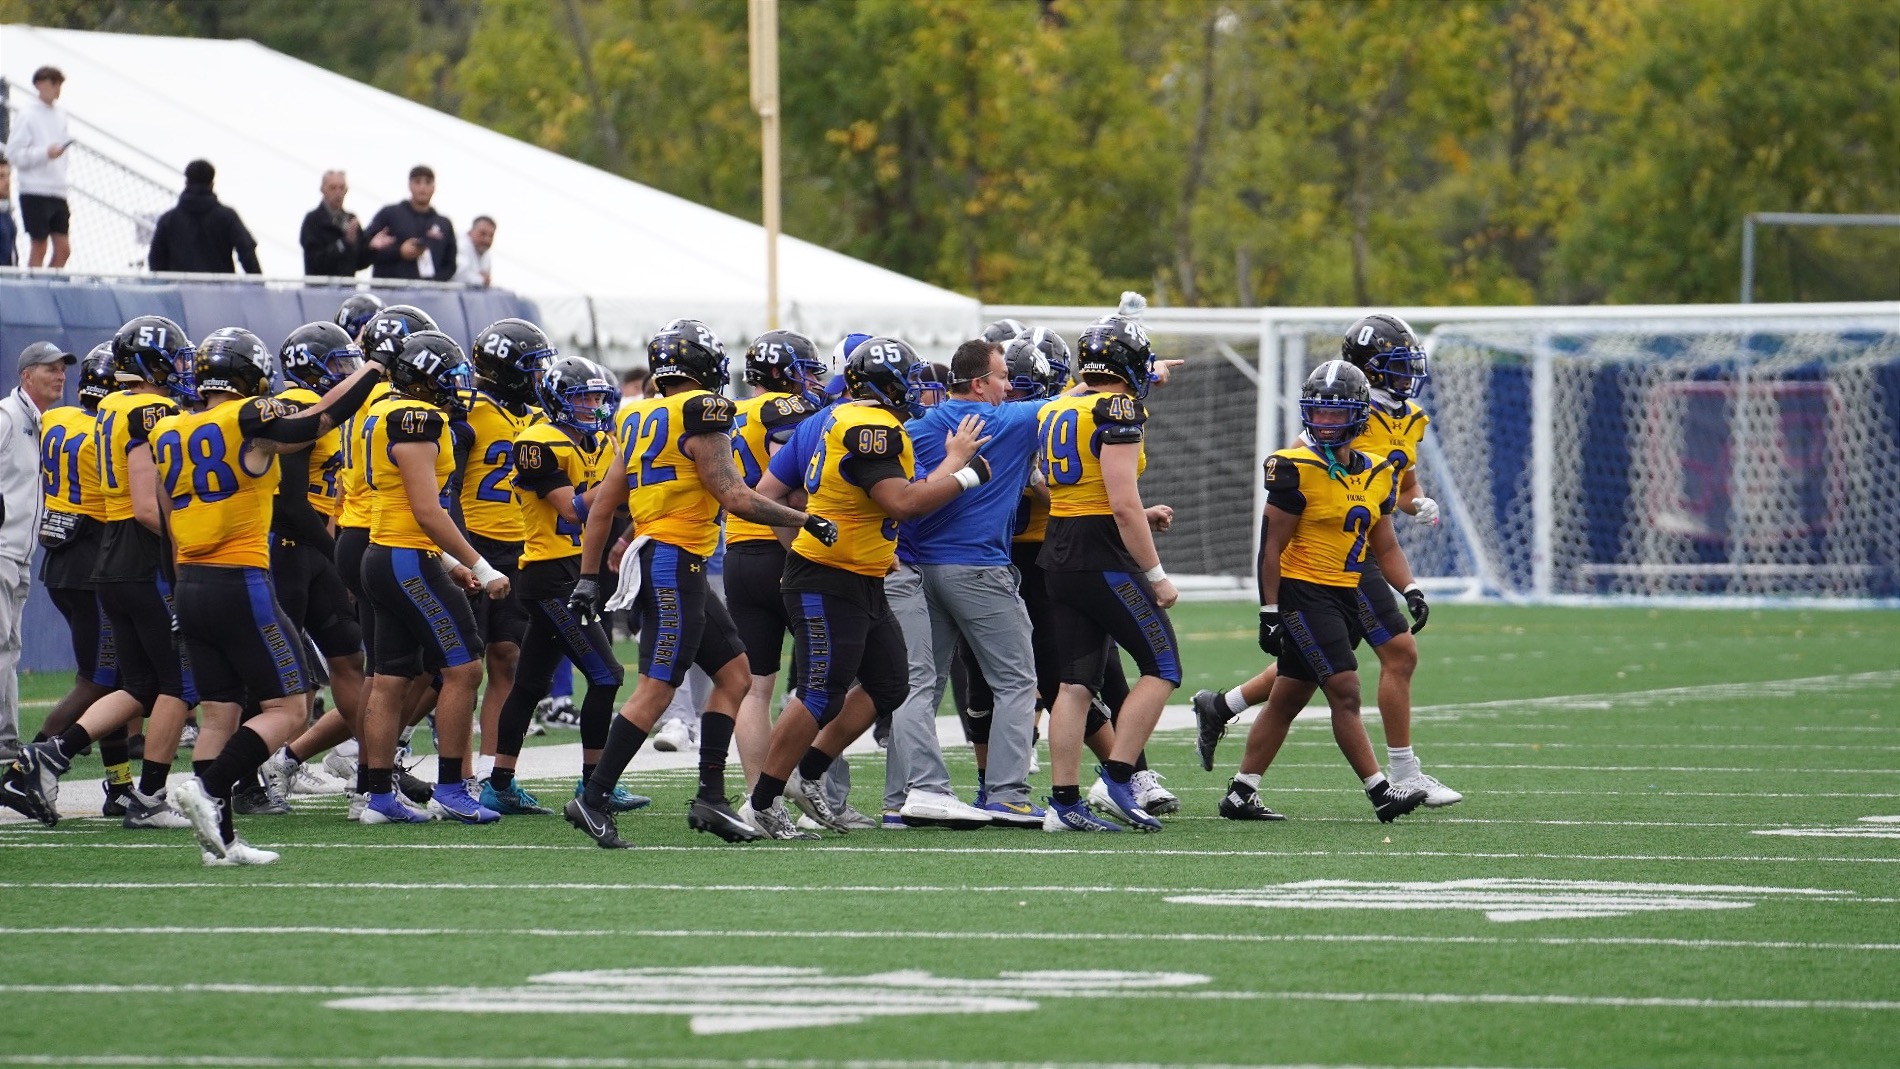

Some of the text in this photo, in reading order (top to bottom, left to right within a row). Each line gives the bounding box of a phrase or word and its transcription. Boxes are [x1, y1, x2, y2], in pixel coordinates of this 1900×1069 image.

[138, 326, 166, 348] 51
[374, 320, 403, 339] 57
[1125, 322, 1149, 347] 49
[1357, 325, 1375, 346] 0
[286, 344, 309, 367] 33
[484, 333, 513, 359] 26
[755, 342, 782, 364] 35
[870, 343, 902, 365] 95
[413, 349, 441, 375] 47
[655, 365, 677, 374] schutt
[1084, 361, 1106, 370] schutt
[203, 378, 228, 387] schutt
[254, 397, 287, 422] 28
[702, 397, 728, 421] 22
[775, 395, 805, 416] 35
[1109, 397, 1135, 420] 49
[401, 411, 428, 433] 47
[621, 407, 678, 490] 22
[859, 429, 887, 454] 95
[43, 425, 88, 505] 91
[157, 423, 240, 510] 28
[520, 445, 541, 469] 43
[1266, 457, 1278, 481] 2
[1343, 505, 1371, 572] 2
[401, 575, 461, 652] NORTH PARK
[1115, 582, 1170, 655] NORTH PARK
[655, 587, 681, 668] NORTH PARK
[261, 623, 295, 668] NORTH
[804, 616, 829, 691] NORTH PARK
